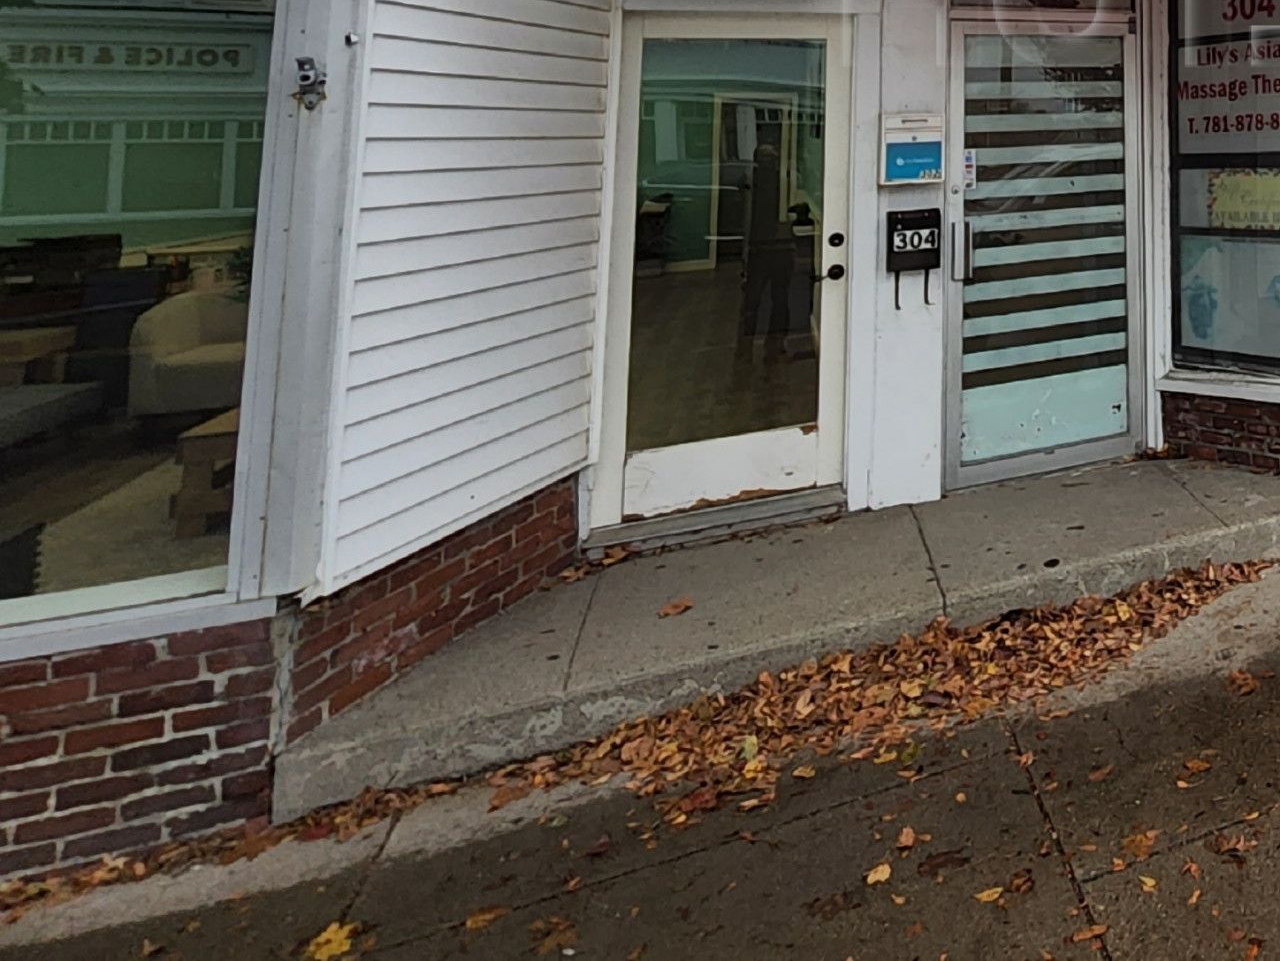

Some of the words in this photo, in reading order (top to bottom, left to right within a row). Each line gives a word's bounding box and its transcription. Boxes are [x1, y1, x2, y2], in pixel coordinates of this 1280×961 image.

[1177, 79, 1248, 102] Massage
[1187, 117, 1199, 134] T.
[896, 229, 937, 251] 304
